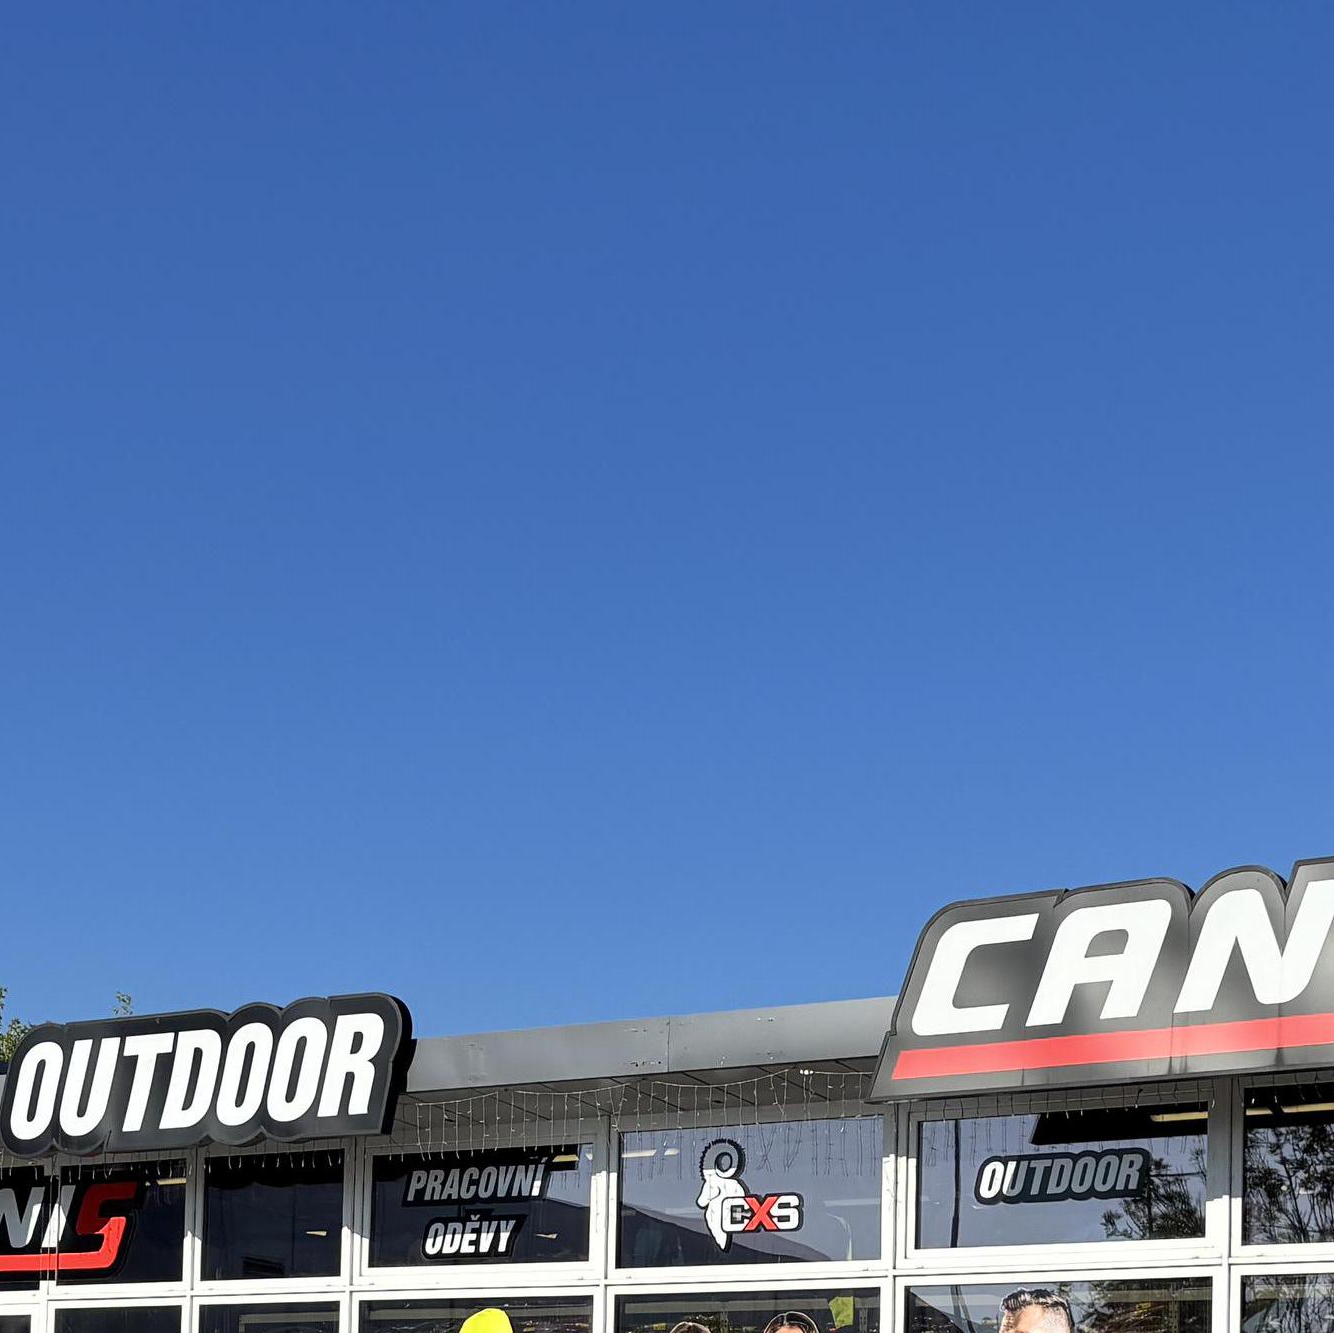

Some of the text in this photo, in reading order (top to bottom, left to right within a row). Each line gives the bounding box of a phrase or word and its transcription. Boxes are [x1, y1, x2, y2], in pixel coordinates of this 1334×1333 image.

[9, 1012, 385, 1141] OUTDOOR
[407, 1157, 547, 1202] PRACOVNÍ
[979, 1153, 1144, 1199] OUTDOOR
[722, 1193, 802, 1233] CXS
[424, 1216, 516, 1256] ODĚVY
